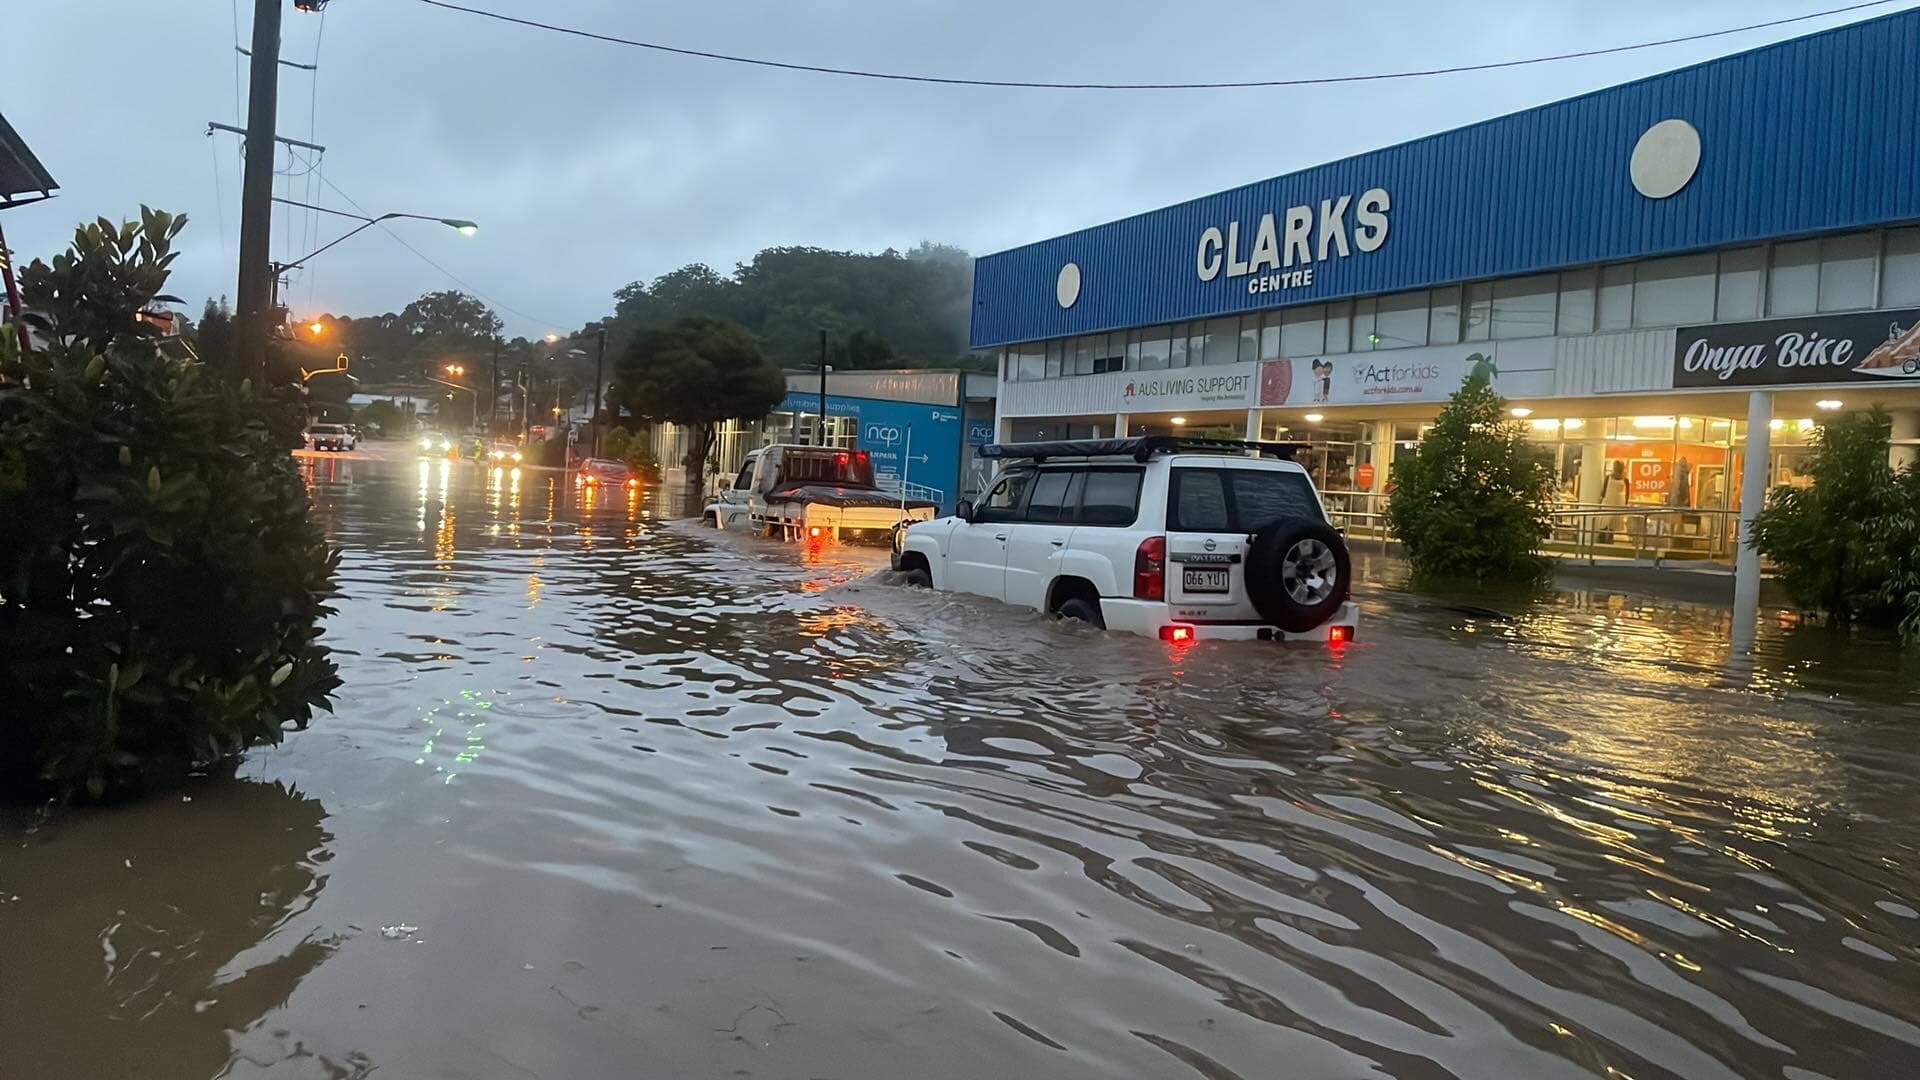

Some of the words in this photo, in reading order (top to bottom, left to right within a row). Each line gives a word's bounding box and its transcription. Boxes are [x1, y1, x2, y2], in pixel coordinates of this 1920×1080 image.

[1197, 187, 1391, 282] CLARKS
[1248, 269, 1314, 295] CENTRE
[1683, 338, 1768, 381] Onya
[1775, 331, 1854, 368] Bike
[1138, 381, 1161, 396] AUS
[1160, 378, 1194, 396] LIVING
[1197, 375, 1251, 393] SUPPORT
[1640, 463, 1662, 477] OP
[1635, 480, 1666, 490] SHOP
[1186, 572, 1204, 586] 066
